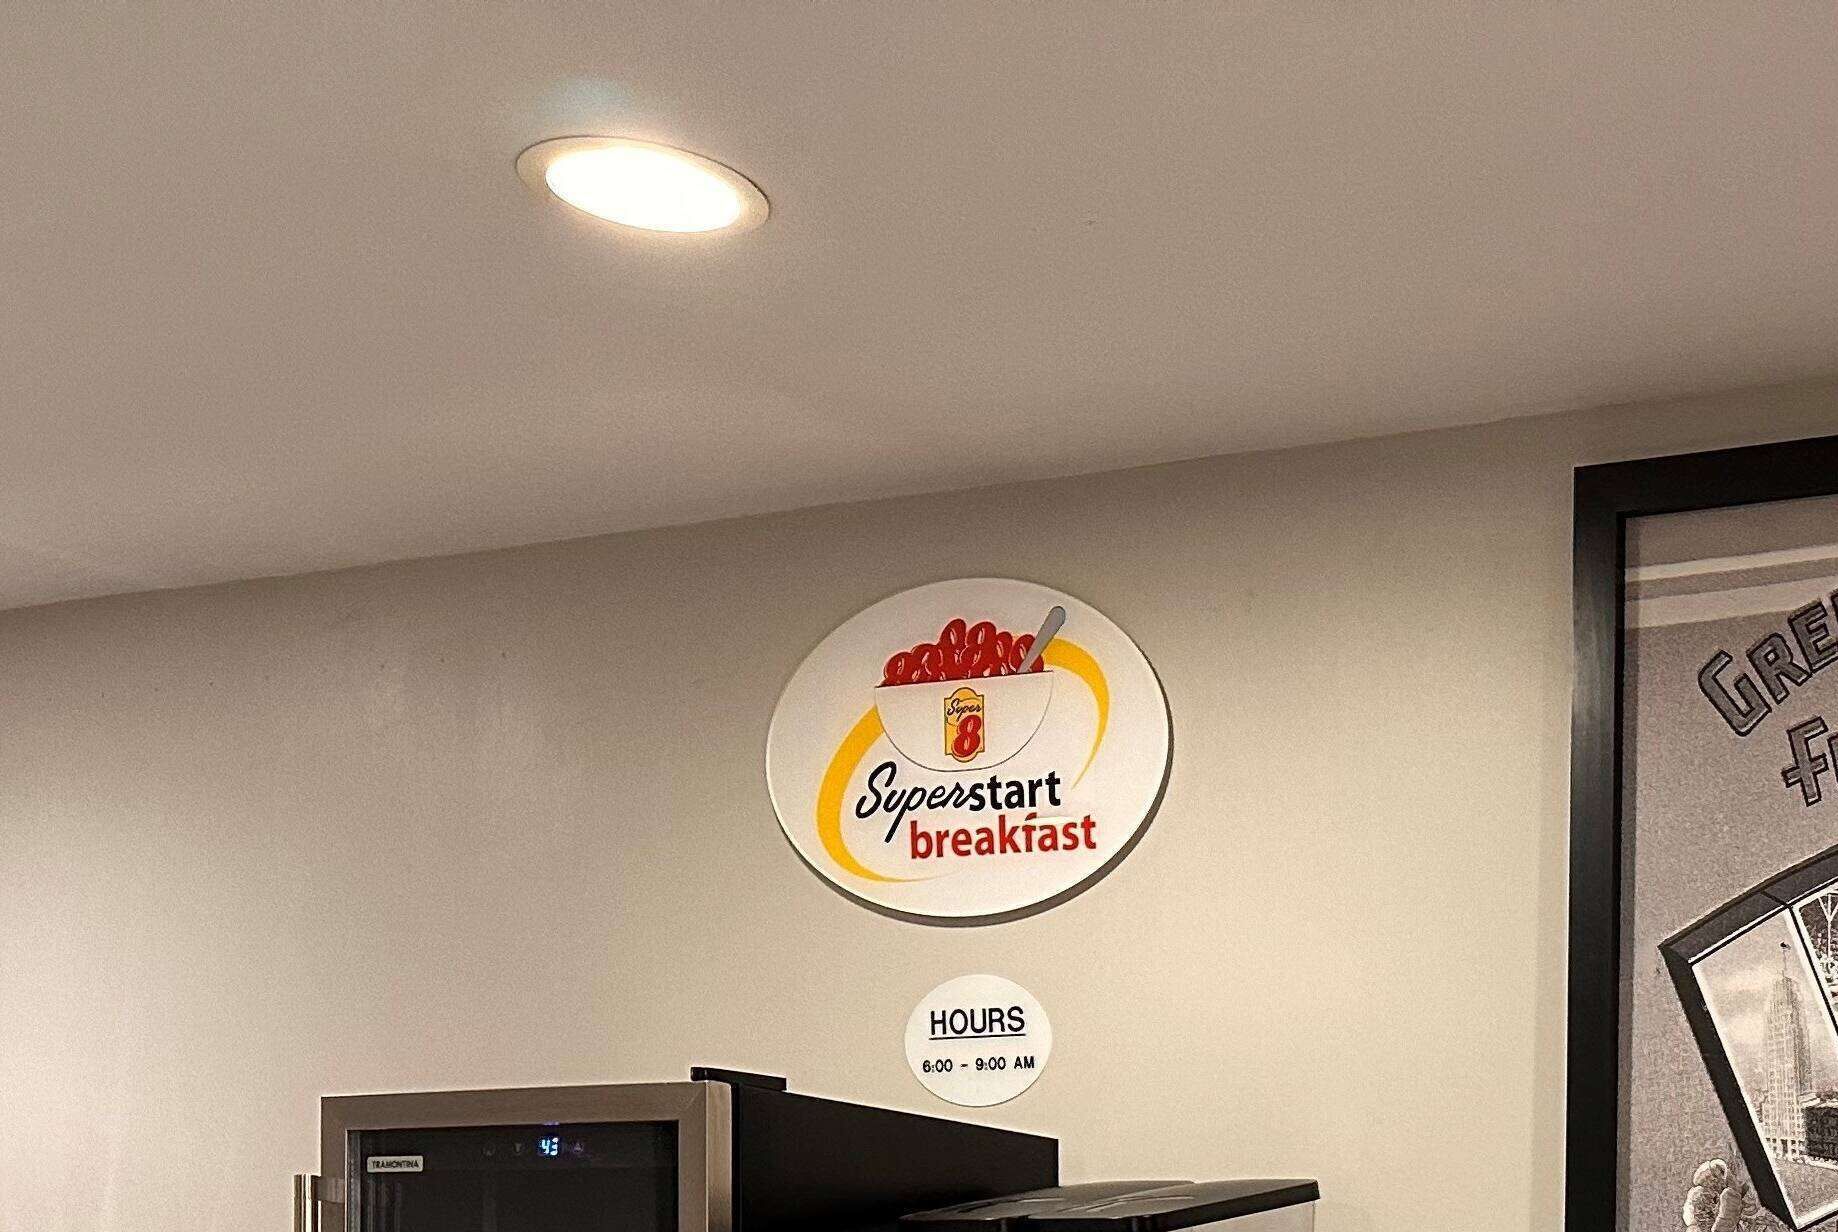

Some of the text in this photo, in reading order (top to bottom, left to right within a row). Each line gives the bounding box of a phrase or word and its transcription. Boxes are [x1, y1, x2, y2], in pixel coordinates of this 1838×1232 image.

[946, 698, 982, 722] Super
[953, 714, 982, 758] 8
[855, 761, 1061, 844] Superstart
[910, 812, 1097, 860] breakfast
[930, 1006, 1025, 1036] HOURS
[922, 1058, 953, 1073] 6:00
[975, 1056, 1006, 1071] 9:00
[1014, 1055, 1035, 1069] AM
